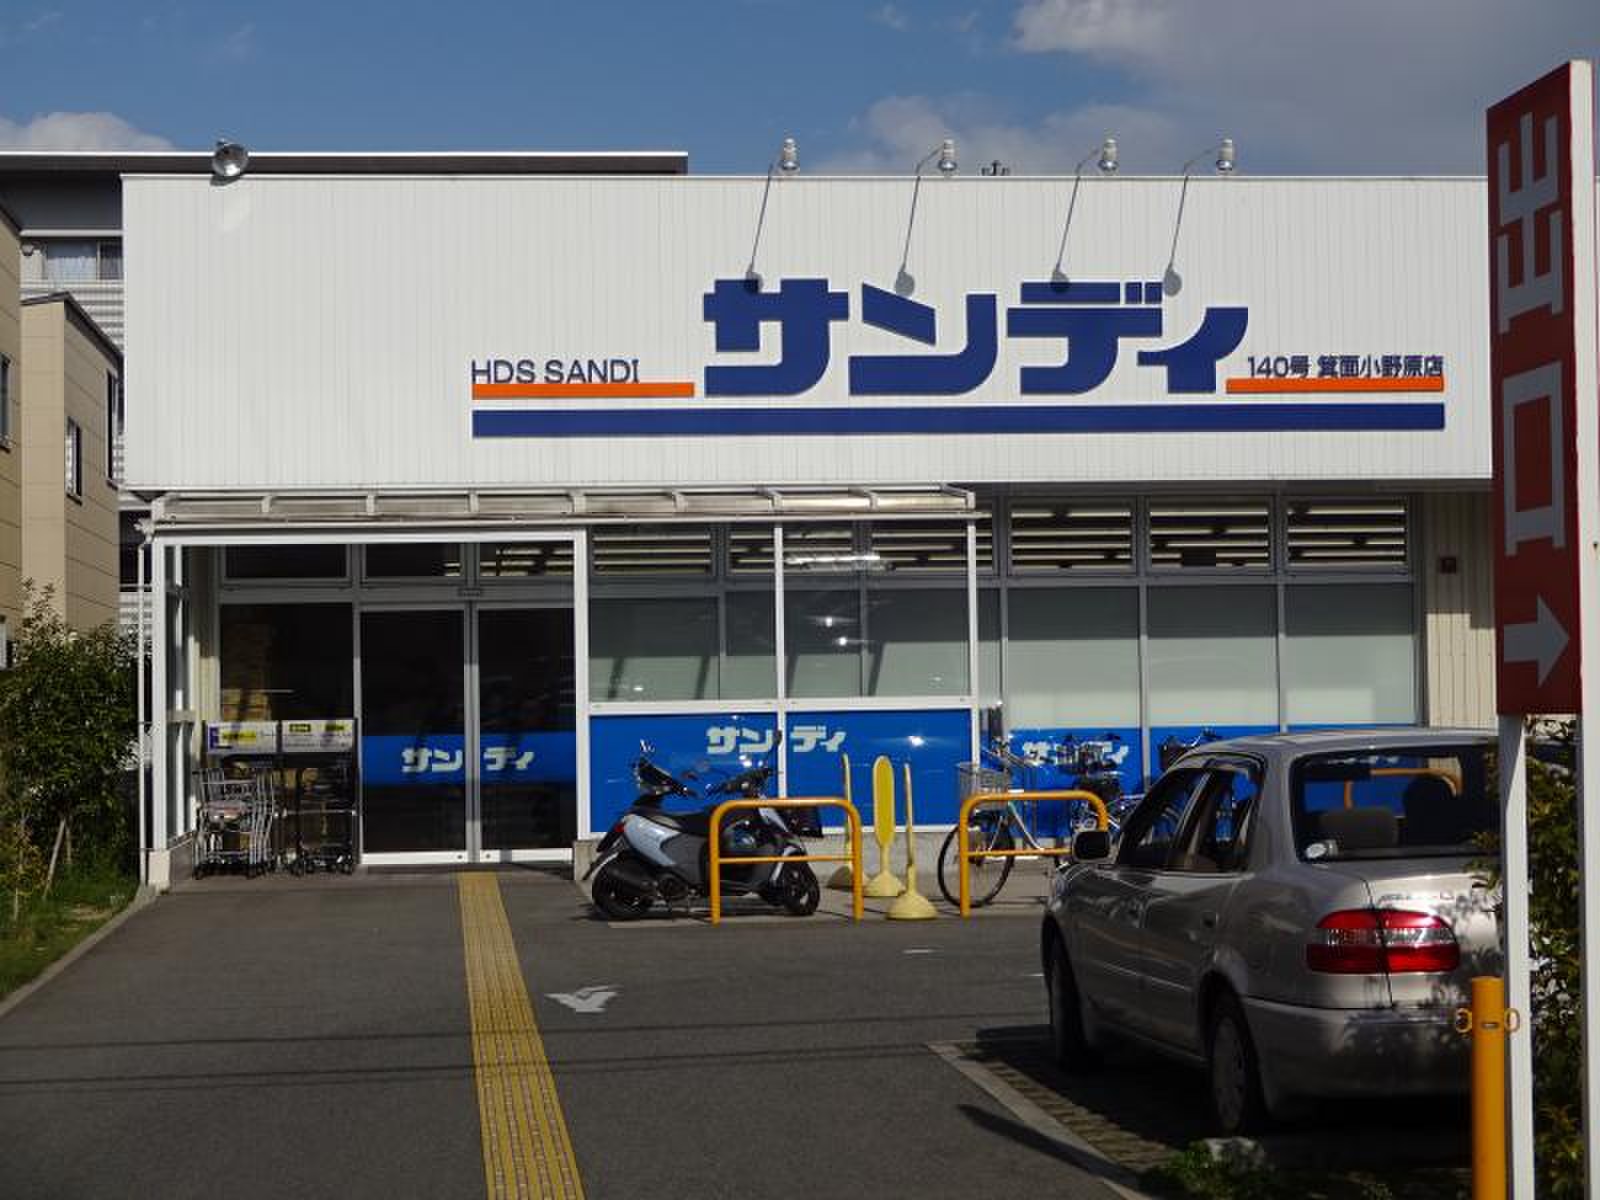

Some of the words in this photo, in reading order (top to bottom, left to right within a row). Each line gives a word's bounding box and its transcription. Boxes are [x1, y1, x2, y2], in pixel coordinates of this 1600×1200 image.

[703, 277, 1249, 395] サンディ
[1496, 111, 1566, 556] 出口
[471, 359, 536, 384] HDS
[544, 359, 639, 384] SANDI
[1248, 355, 1311, 378] 140号
[1317, 355, 1444, 377] 箕面小野原店
[706, 725, 846, 754] サンディ
[402, 747, 534, 772] サンディ
